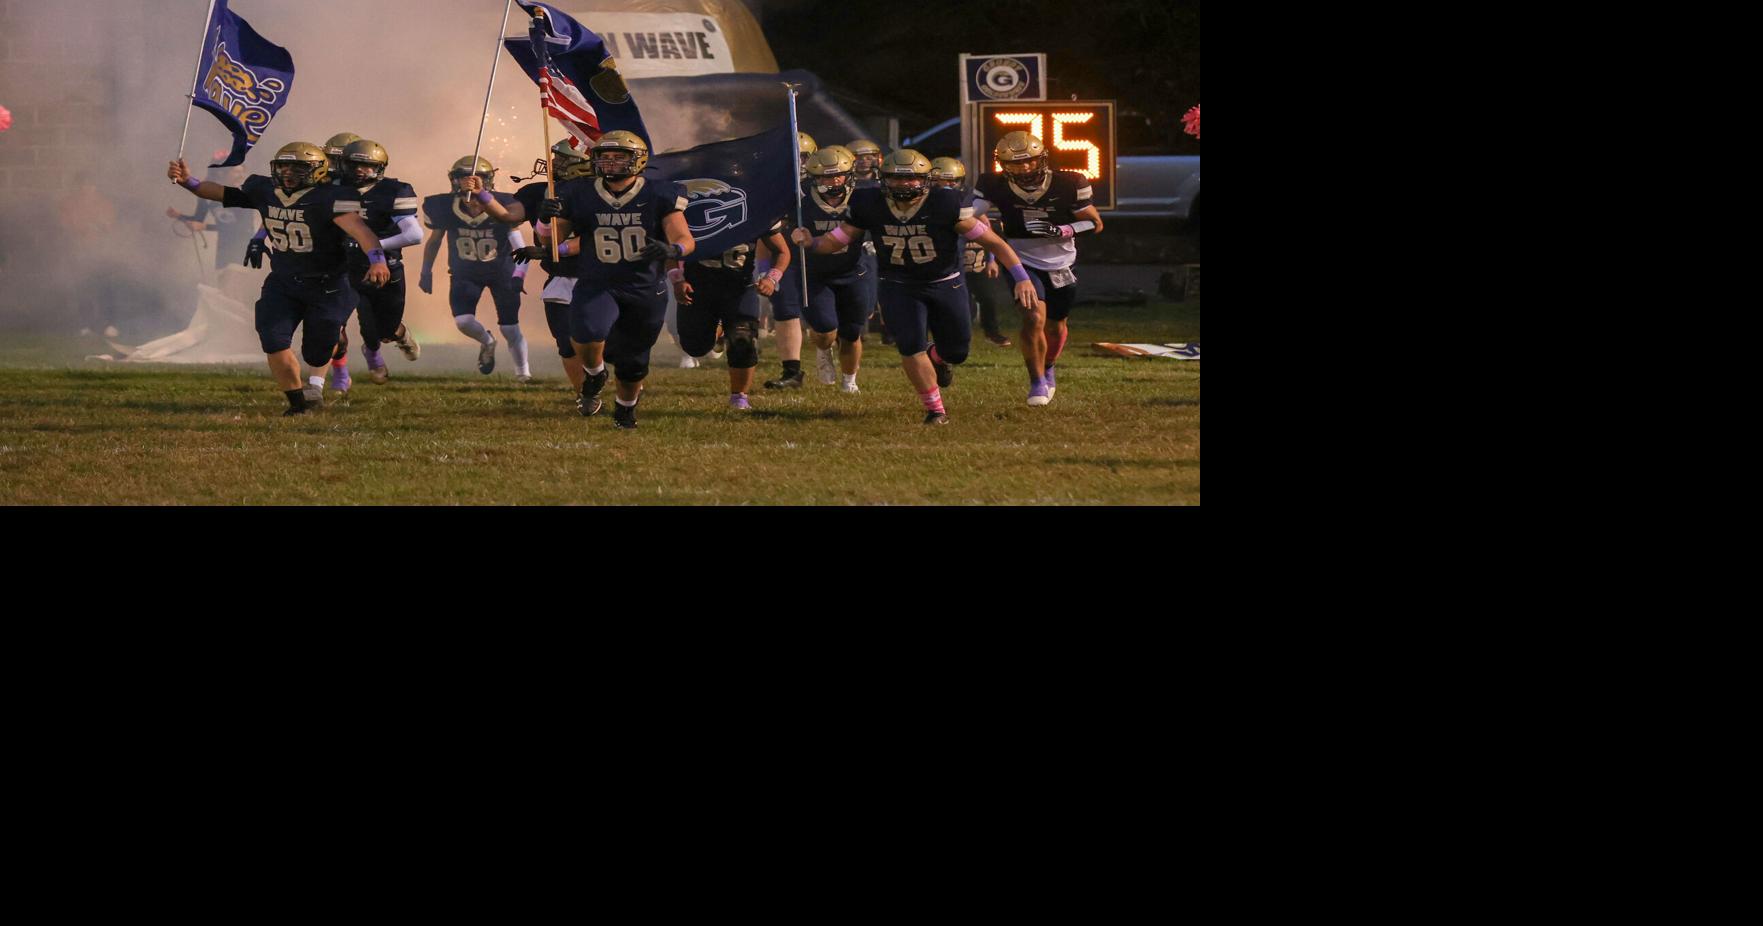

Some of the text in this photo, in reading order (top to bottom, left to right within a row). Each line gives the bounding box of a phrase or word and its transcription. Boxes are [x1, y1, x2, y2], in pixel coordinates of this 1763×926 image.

[623, 31, 715, 59] WAVE
[267, 206, 305, 221] WAVE
[595, 212, 643, 226] WAVE
[264, 218, 314, 253] 50
[458, 228, 494, 238] WAVE
[883, 224, 928, 236] WAVE
[594, 226, 647, 264] 60
[881, 235, 937, 265] 70
